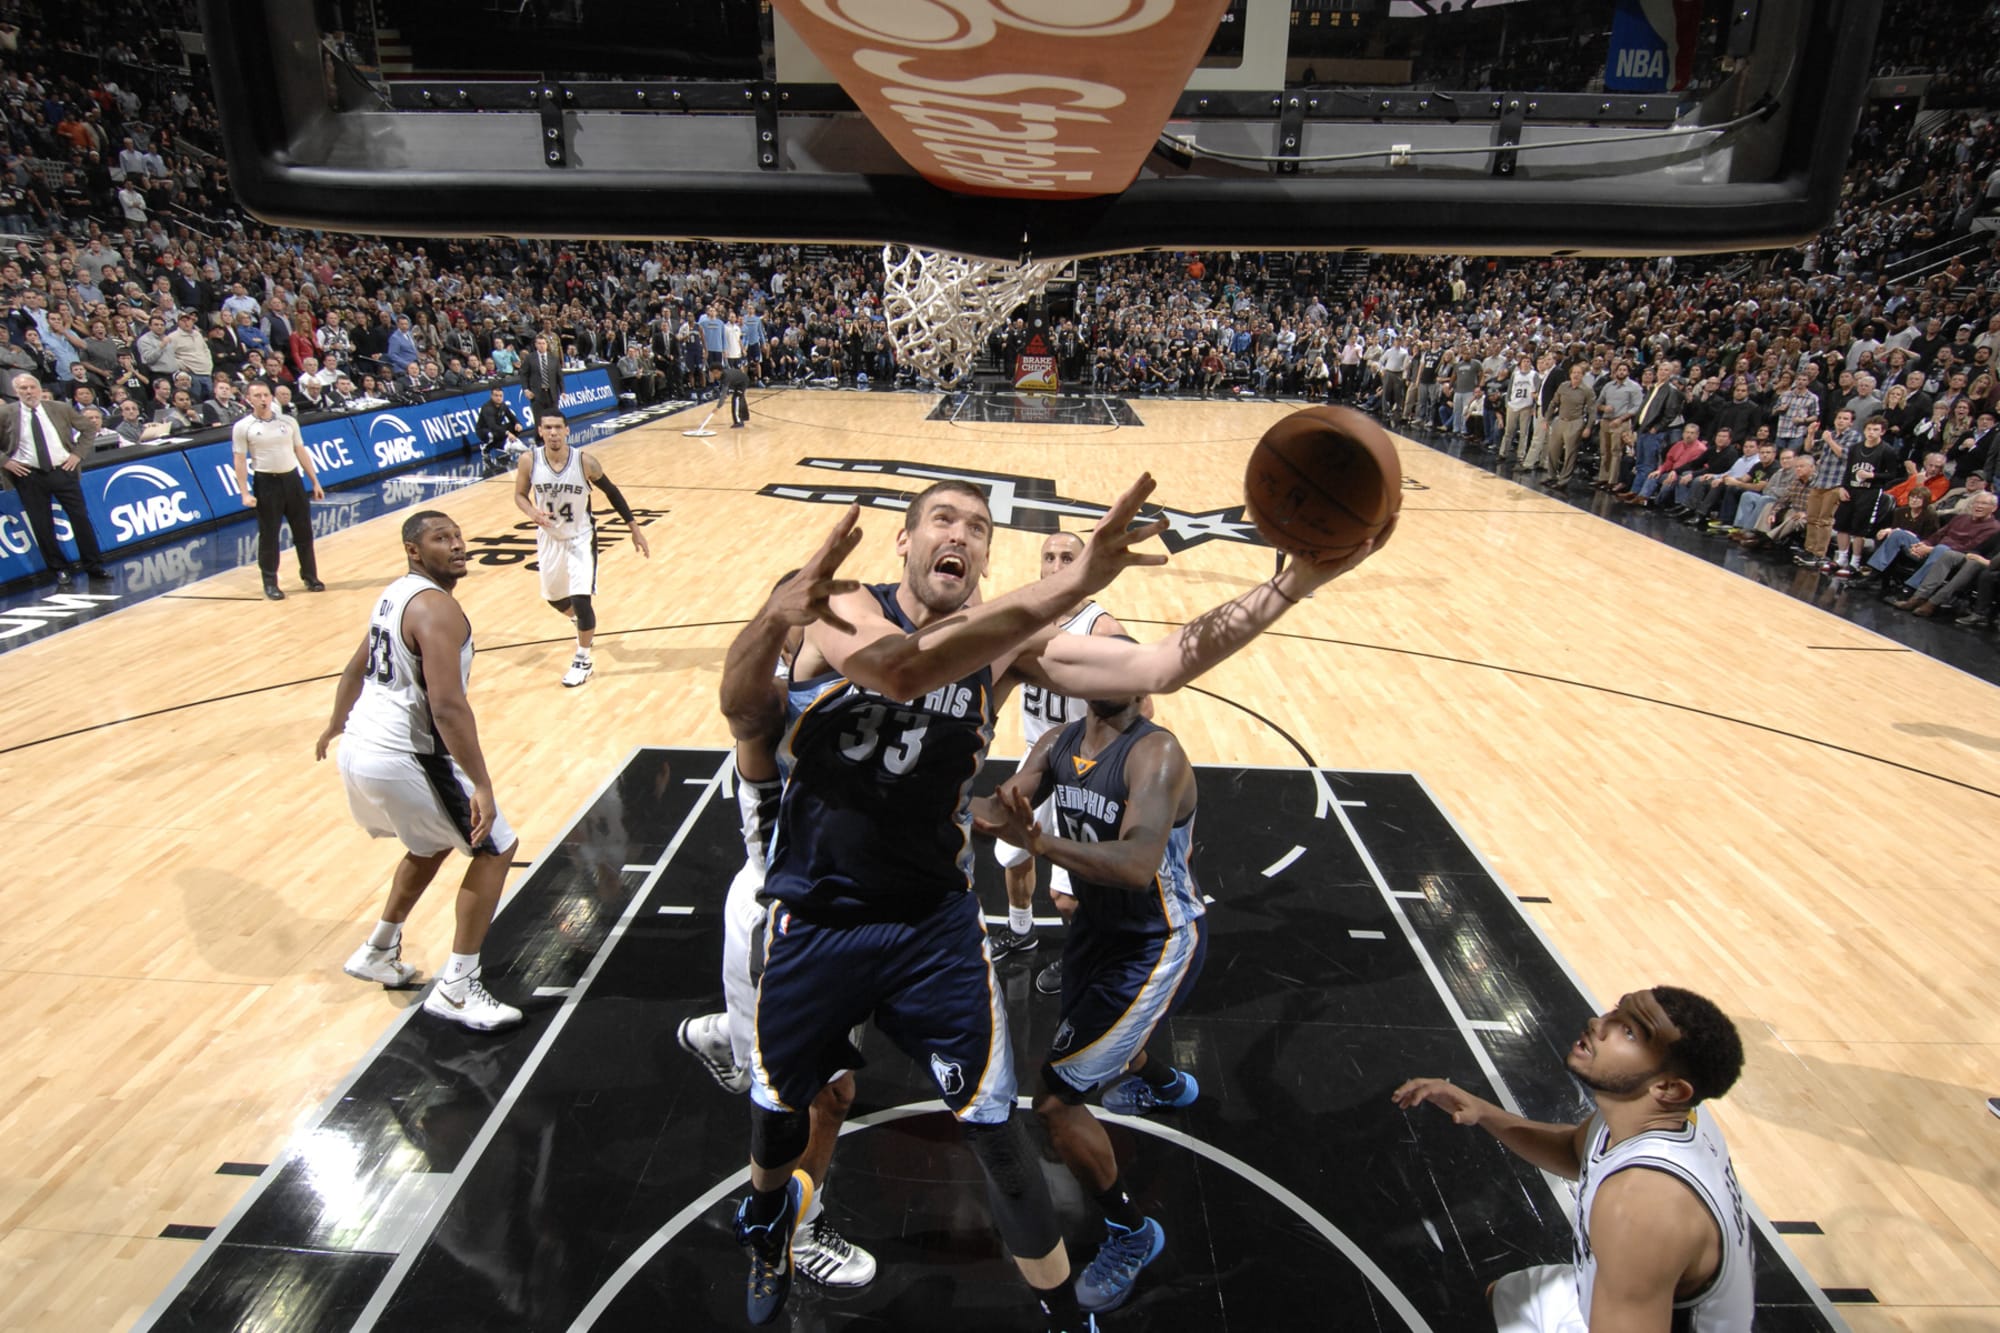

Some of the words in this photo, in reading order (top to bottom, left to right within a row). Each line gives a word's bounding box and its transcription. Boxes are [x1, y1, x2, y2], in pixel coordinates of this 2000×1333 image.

[1616, 48, 1664, 79] NBA
[1022, 356, 1053, 364] BRAKE
[1515, 389, 1528, 398] 21
[374, 435, 424, 468] SWBC
[534, 483, 583, 495] SPURS
[110, 491, 194, 543] SWBC
[545, 502, 574, 523] 14
[364, 625, 396, 686] 33
[1024, 683, 1067, 724] 20
[839, 701, 931, 776] 33
[1055, 783, 1120, 825] EMPHIS
